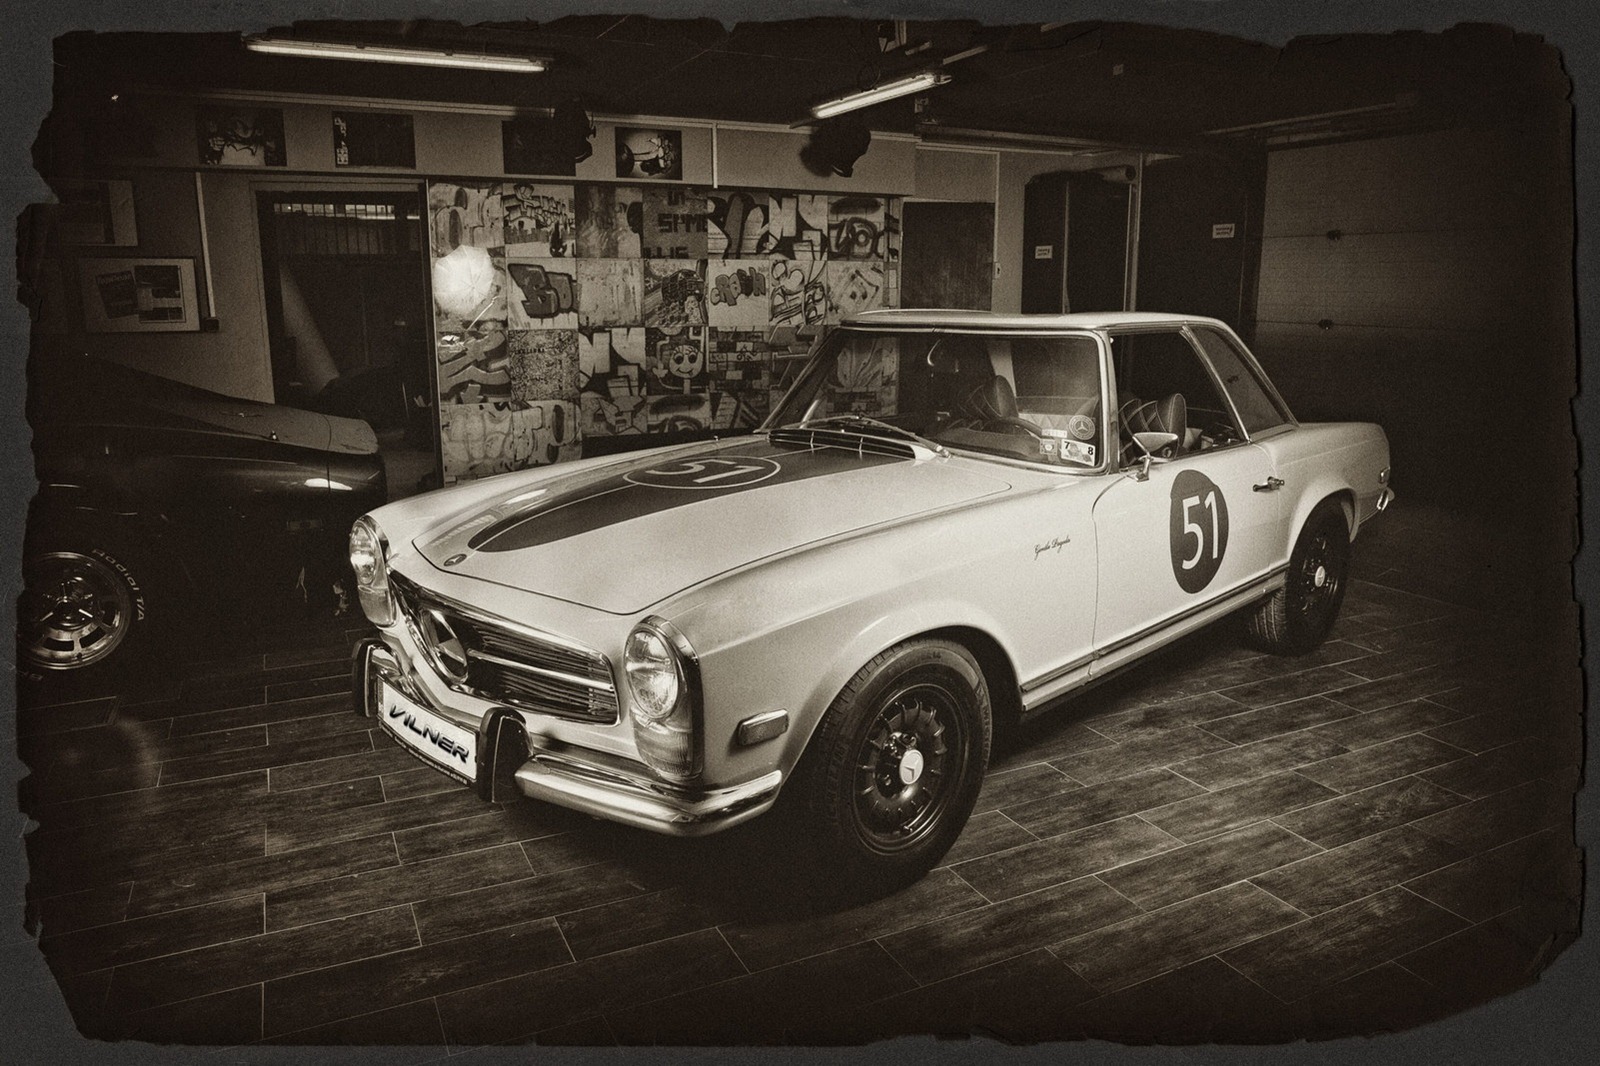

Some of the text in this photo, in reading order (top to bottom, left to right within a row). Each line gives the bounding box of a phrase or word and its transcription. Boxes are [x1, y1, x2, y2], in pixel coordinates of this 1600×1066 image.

[1064, 440, 1071, 450] 7
[1087, 446, 1094, 456] 8
[645, 459, 765, 484] 51
[1182, 490, 1219, 570] 51
[389, 704, 469, 763] VILNER
